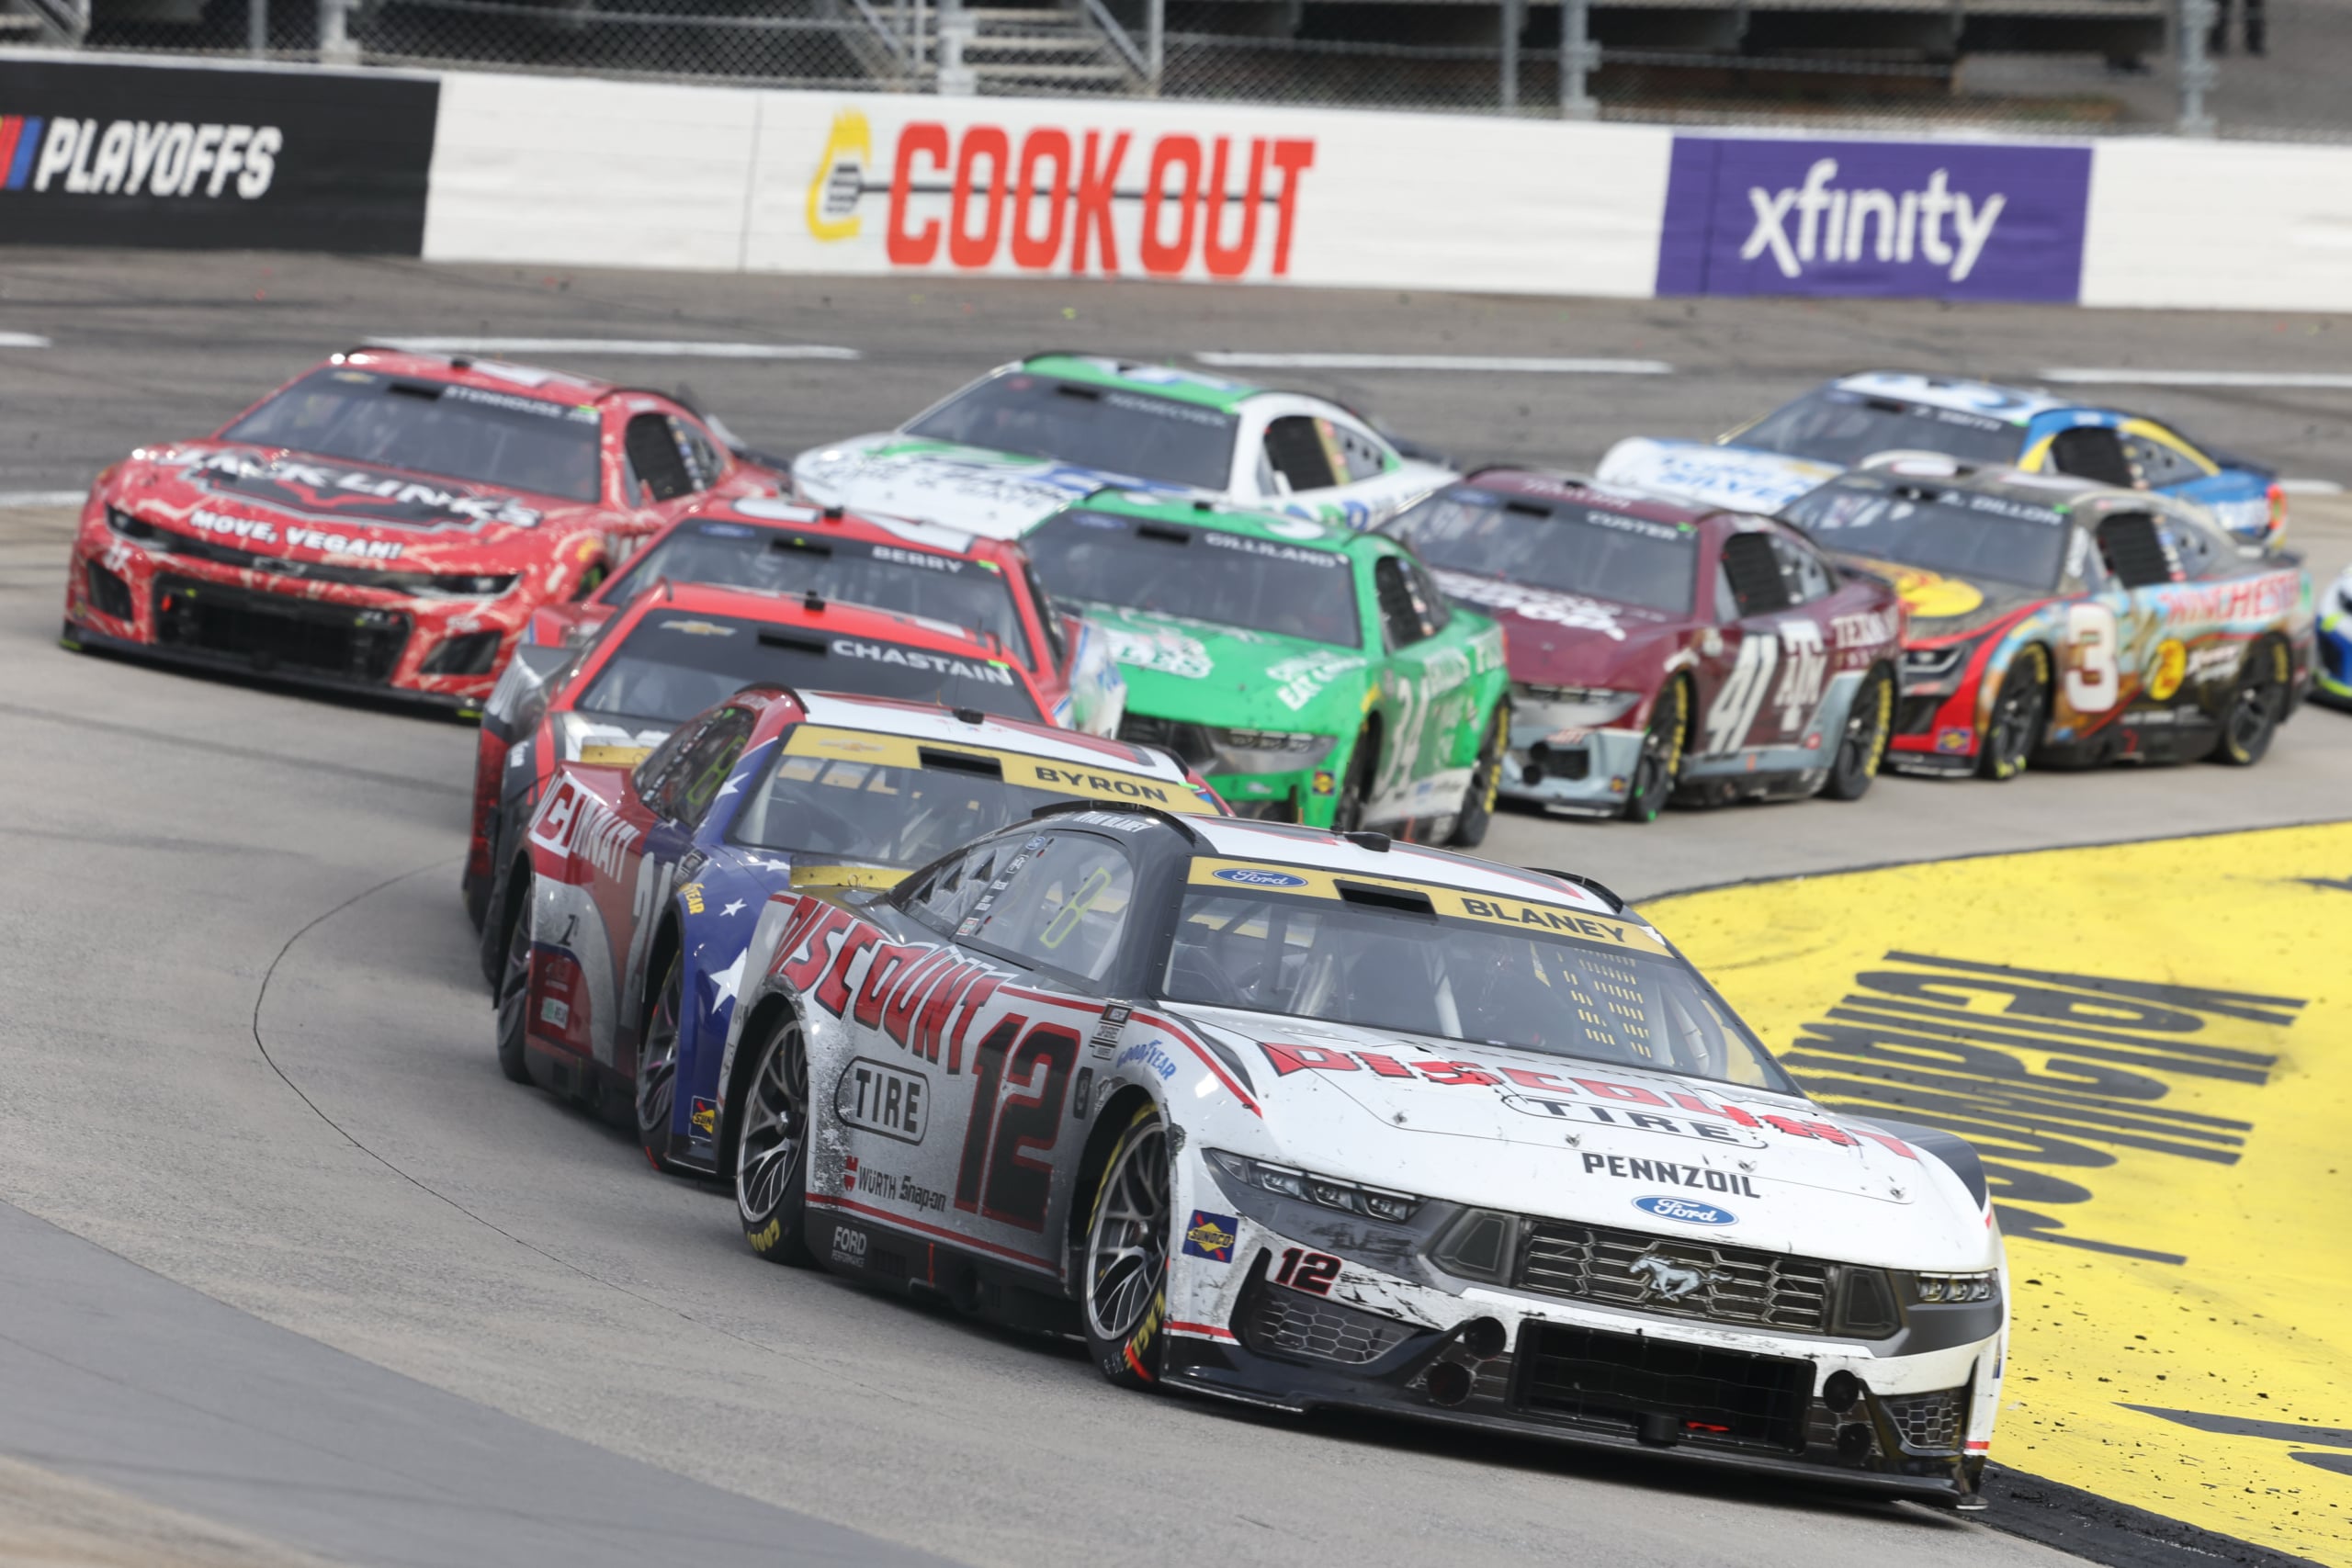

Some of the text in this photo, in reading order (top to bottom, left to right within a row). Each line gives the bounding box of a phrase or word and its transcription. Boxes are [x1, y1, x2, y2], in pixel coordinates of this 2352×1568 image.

[34, 117, 283, 198] PLAYOFFS
[1741, 158, 2007, 282] xfinity
[1587, 510, 1679, 542] CUSTER
[1972, 495, 2064, 527] DILLON
[188, 509, 405, 560] MOVE, VEGAN!
[1204, 533, 1336, 569] GILLILAND
[872, 544, 964, 574] BERRY
[832, 639, 1012, 686] CHASTAIN
[2064, 604, 2118, 714] 3
[1706, 633, 1778, 755] 41
[1035, 766, 1169, 804] BYRON
[1229, 869, 1291, 887] Ford
[1461, 897, 1630, 942] BLANEY
[767, 895, 1013, 1076] DISCOUNT
[1116, 1039, 1176, 1081] GOODYEAR
[855, 1062, 921, 1135] TIRE
[1526, 1098, 1743, 1144] TIRE
[954, 1013, 1081, 1235] 12
[899, 1175, 947, 1213] Snap-on
[1581, 1152, 1761, 1200] PENNZOIL
[1650, 1198, 1719, 1224] Ford
[833, 1225, 867, 1256] FORD
[1188, 1227, 1234, 1247] SUNOCO
[1274, 1247, 1341, 1296] 12
